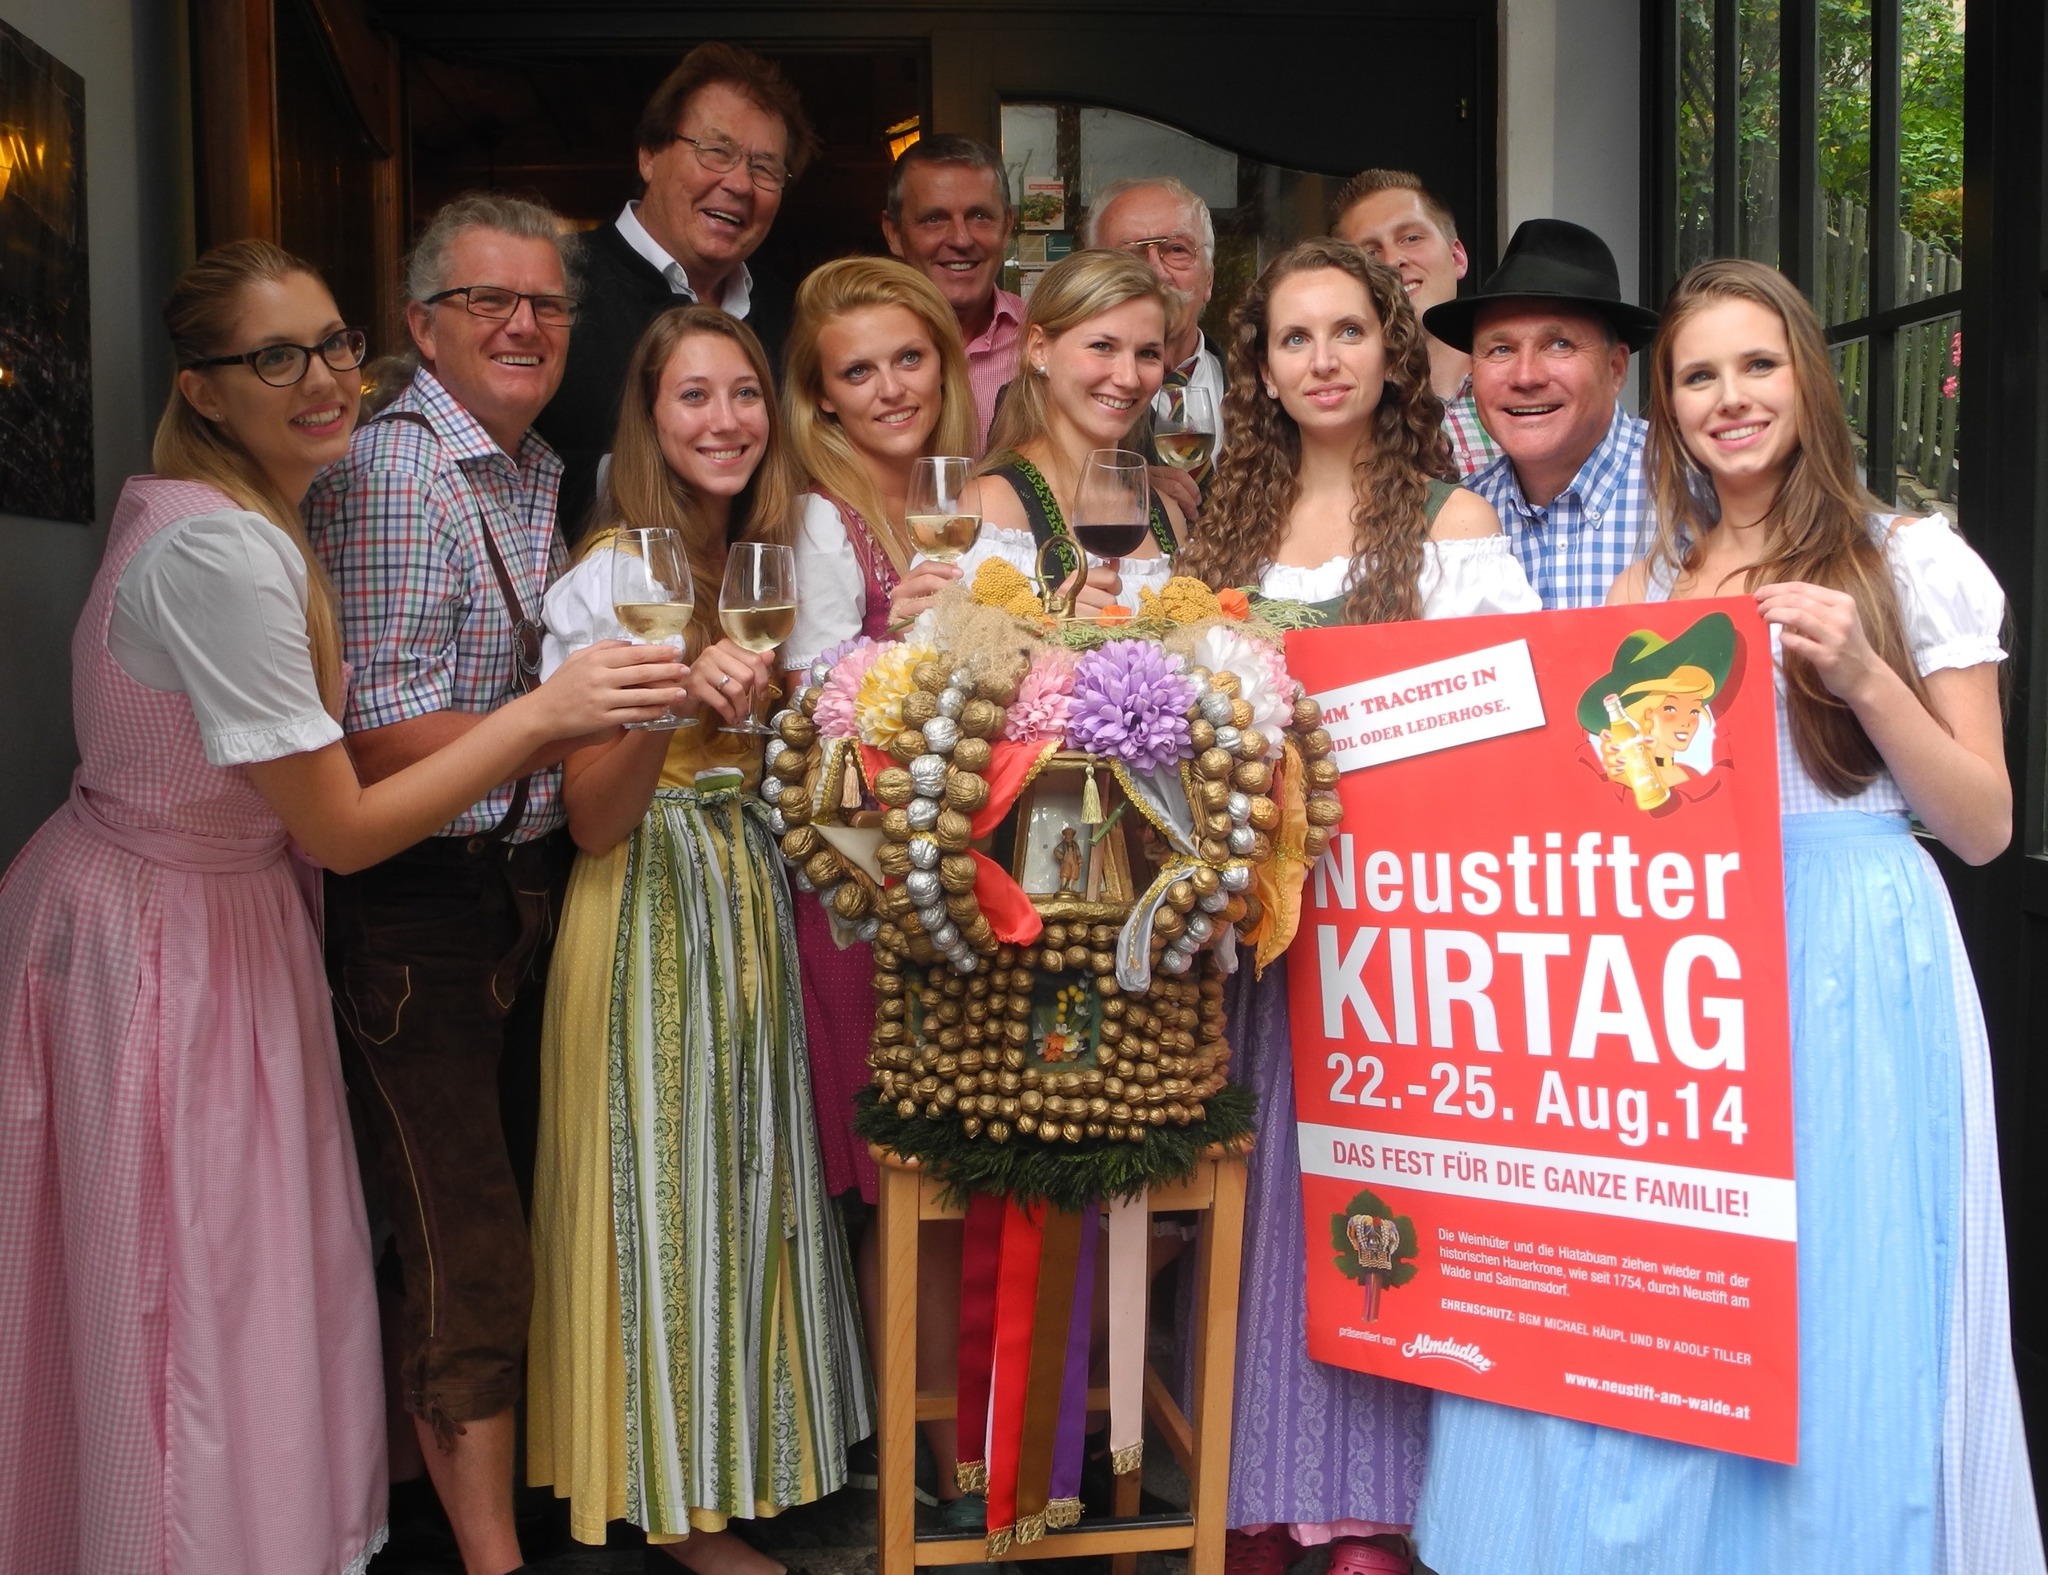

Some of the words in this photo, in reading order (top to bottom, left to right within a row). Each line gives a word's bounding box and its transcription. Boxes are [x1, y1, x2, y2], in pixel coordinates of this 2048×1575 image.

[1360, 675, 1468, 715] TRACHTIG
[1473, 666, 1498, 687] IN
[1360, 724, 1403, 746] ODER
[1407, 698, 1511, 735] LEDERHOSE.
[1314, 832, 1740, 920] Neustifter
[1317, 924, 1746, 1072] KIRTAG
[1327, 1052, 1514, 1121] 22.-25.
[1333, 1140, 1375, 1168] DAS
[1382, 1149, 1435, 1176] FEST
[1444, 1151, 1488, 1184] FÜR
[1497, 1161, 1535, 1189] DIE
[1544, 1166, 1627, 1201] GANZE
[1636, 1177, 1750, 1218] FAMILIE!
[1438, 1228, 1455, 1241] Die
[1458, 1231, 1510, 1250] Weinhüter
[1514, 1239, 1534, 1254] und
[1537, 1244, 1554, 1257] die
[1558, 1246, 1618, 1267] Hiatabuam
[1621, 1256, 1658, 1274] ziehen
[1662, 1263, 1702, 1280] wieder
[1706, 1270, 1726, 1285] mit
[1729, 1274, 1750, 1288] der
[1439, 1246, 1501, 1266] historischen
[1503, 1256, 1566, 1279] Hauerkrone,
[1568, 1267, 1588, 1281] wie
[1590, 1271, 1610, 1285] seit
[1613, 1273, 1645, 1293] 1754,
[1647, 1279, 1680, 1297] durch
[1683, 1284, 1728, 1305] Neustift
[1730, 1294, 1750, 1308] am
[1440, 1263, 1471, 1280] Walde
[1474, 1271, 1493, 1283] und
[1495, 1272, 1571, 1297] Salmannsdorf.
[1338, 1327, 1381, 1344] präsentiert
[1382, 1335, 1396, 1347] von
[1402, 1333, 1492, 1374] Almdudler
[1441, 1298, 1516, 1322] EHRENSCHUTZ:
[1518, 1312, 1541, 1327] BGM
[1544, 1317, 1589, 1336] MICHAEL
[1592, 1324, 1626, 1343] HÄUPL
[1630, 1333, 1653, 1347] UND
[1656, 1338, 1671, 1350] BV
[1673, 1341, 1710, 1358] ADOLF
[1712, 1347, 1752, 1366] TILLER
[1564, 1372, 1751, 1420] www.neustift-am-walde.at
